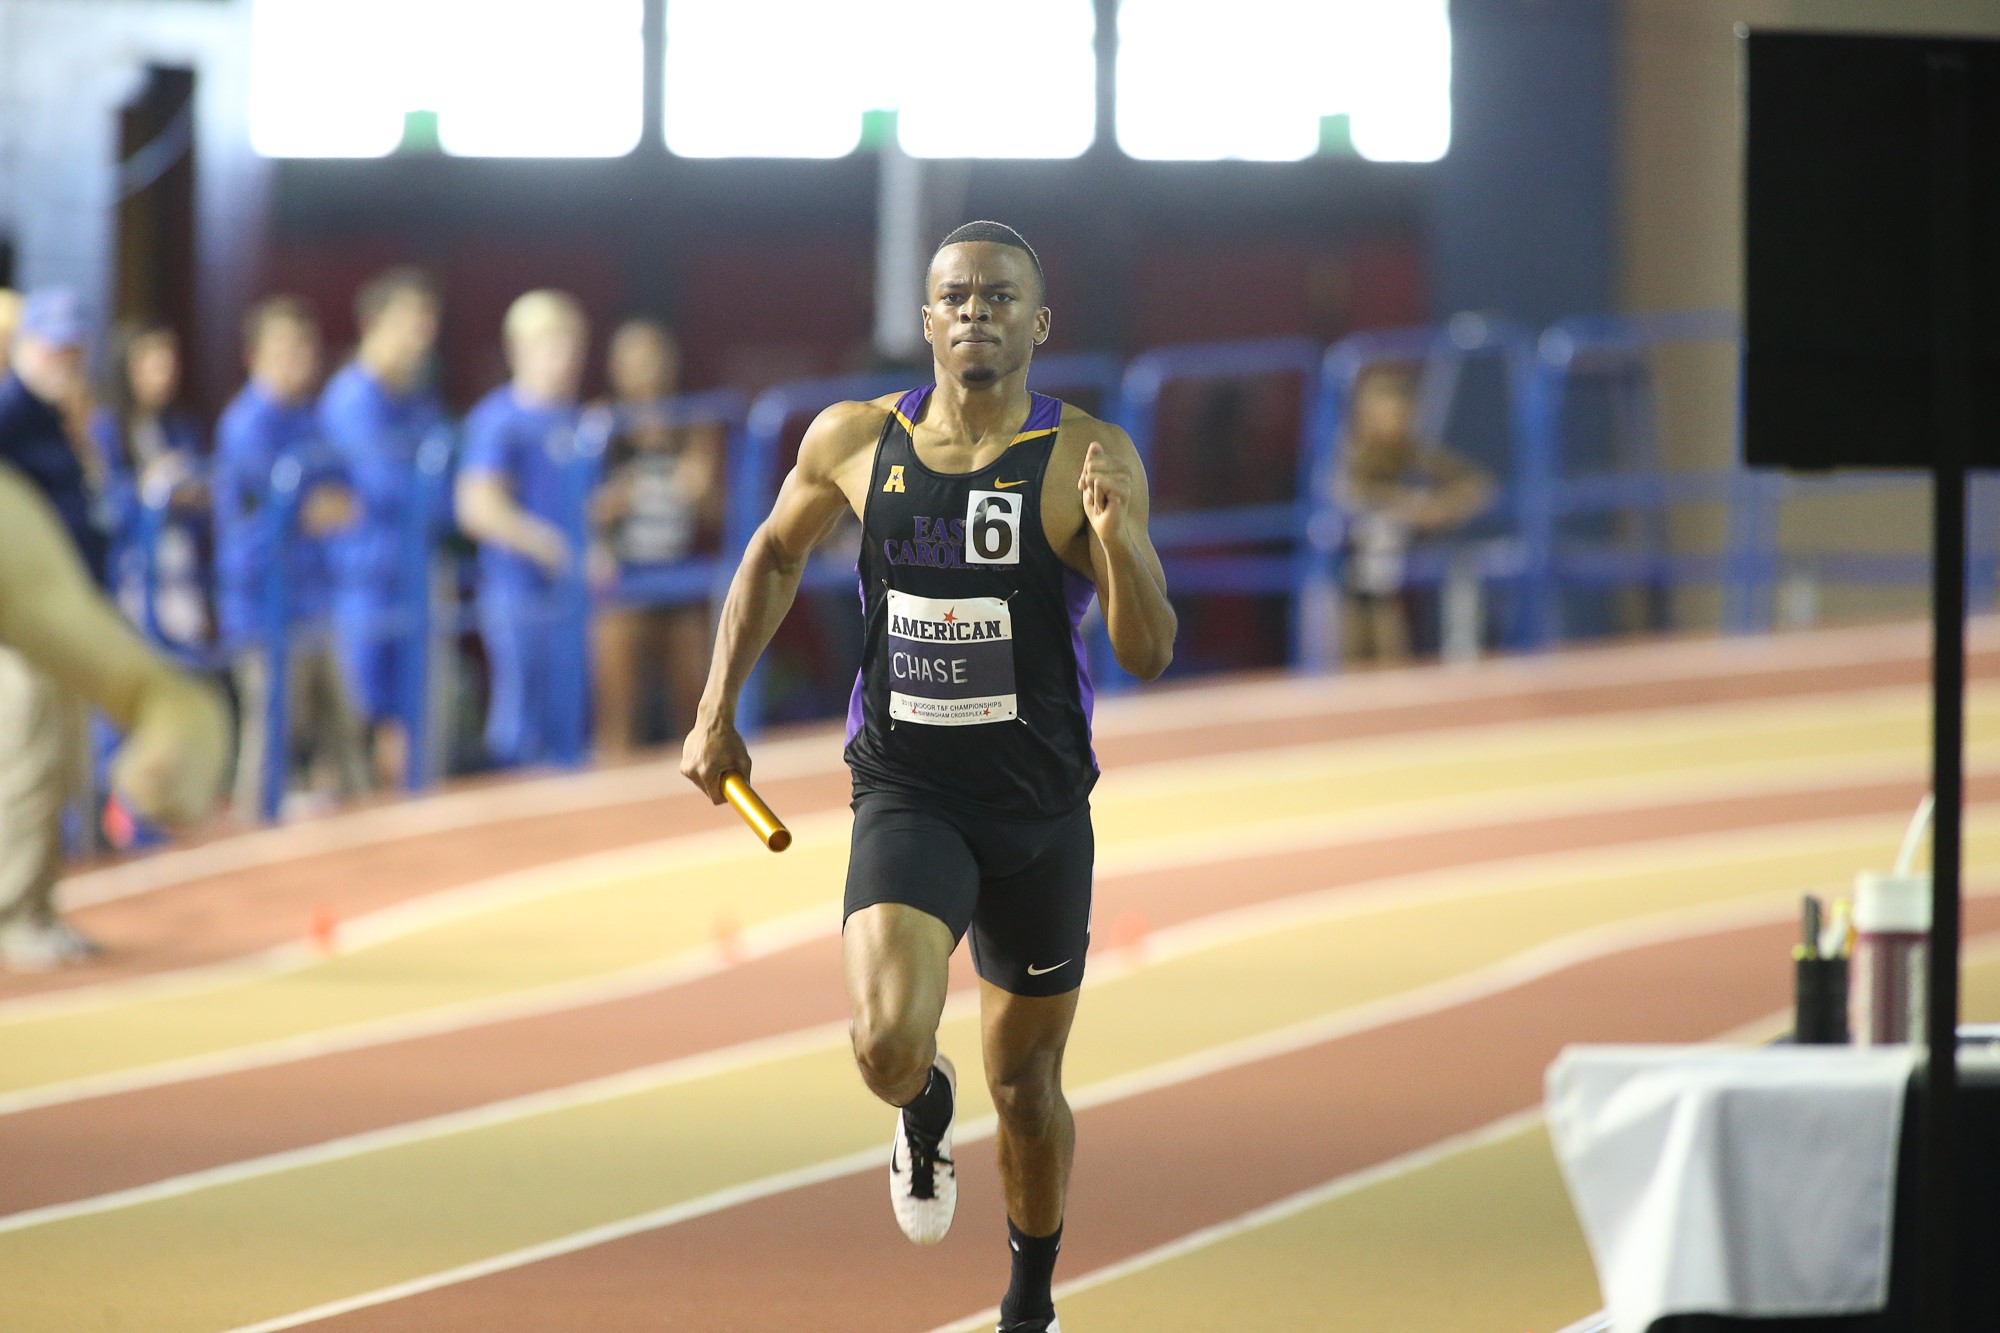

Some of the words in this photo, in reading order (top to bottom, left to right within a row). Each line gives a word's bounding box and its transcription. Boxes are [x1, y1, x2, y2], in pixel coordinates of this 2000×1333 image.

[913, 515, 967, 543] EAS
[972, 496, 1013, 560] 6
[892, 614, 1002, 641] AMERICAN
[893, 651, 968, 684] CHASE
[918, 710, 950, 718] BIRMINGHAM
[949, 701, 1002, 711] CHAMPIONSHIPS
